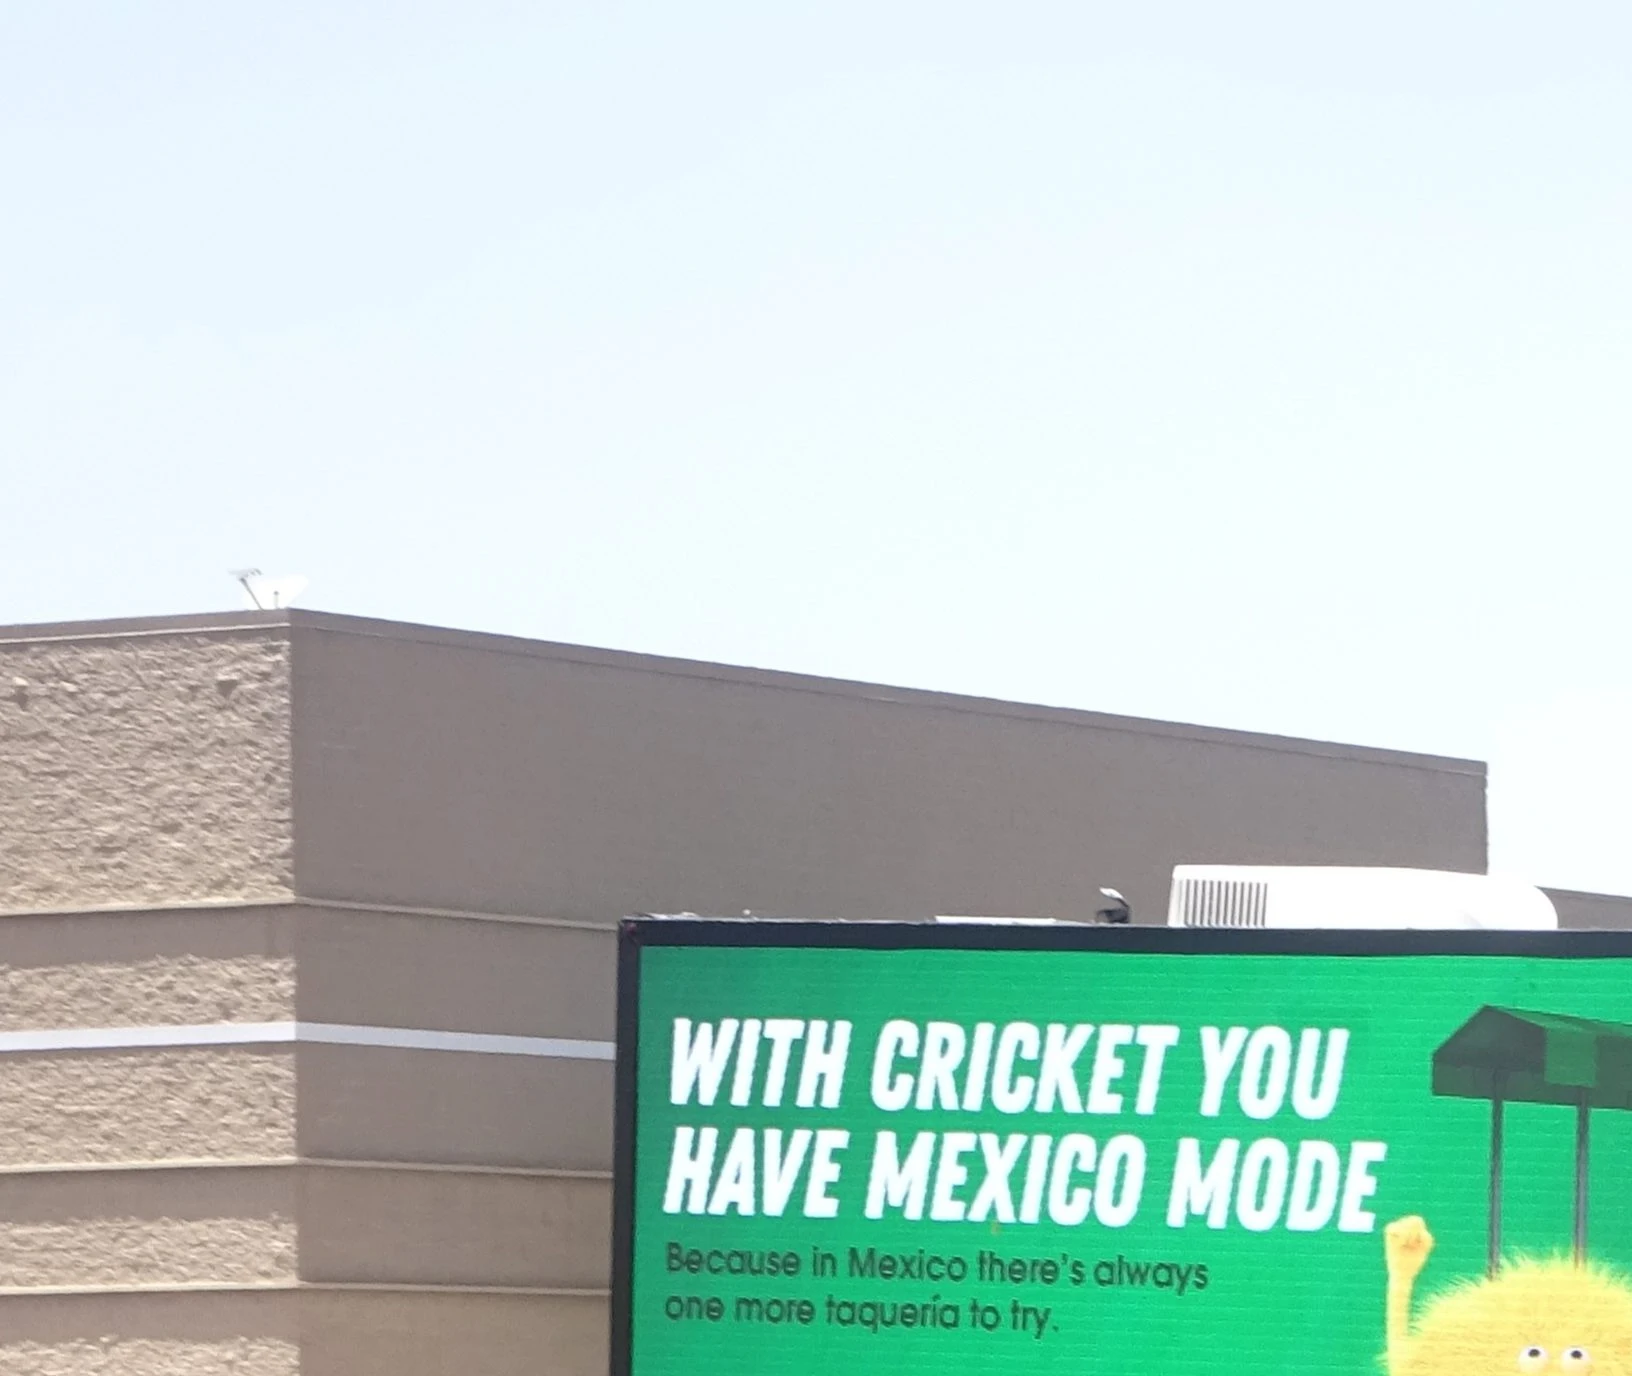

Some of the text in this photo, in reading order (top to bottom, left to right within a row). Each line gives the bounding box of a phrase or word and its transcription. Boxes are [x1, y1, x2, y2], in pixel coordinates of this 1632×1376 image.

[670, 1017, 1350, 1120] WITH CRICKET YOU
[663, 1126, 1388, 1234] HAVE MEXICO MODE
[666, 1242, 1208, 1296] Because in Mexico there's always
[665, 1295, 725, 1321] one
[734, 1296, 816, 1325] more
[970, 1298, 1001, 1331] to
[1010, 1299, 1059, 1340] try.
